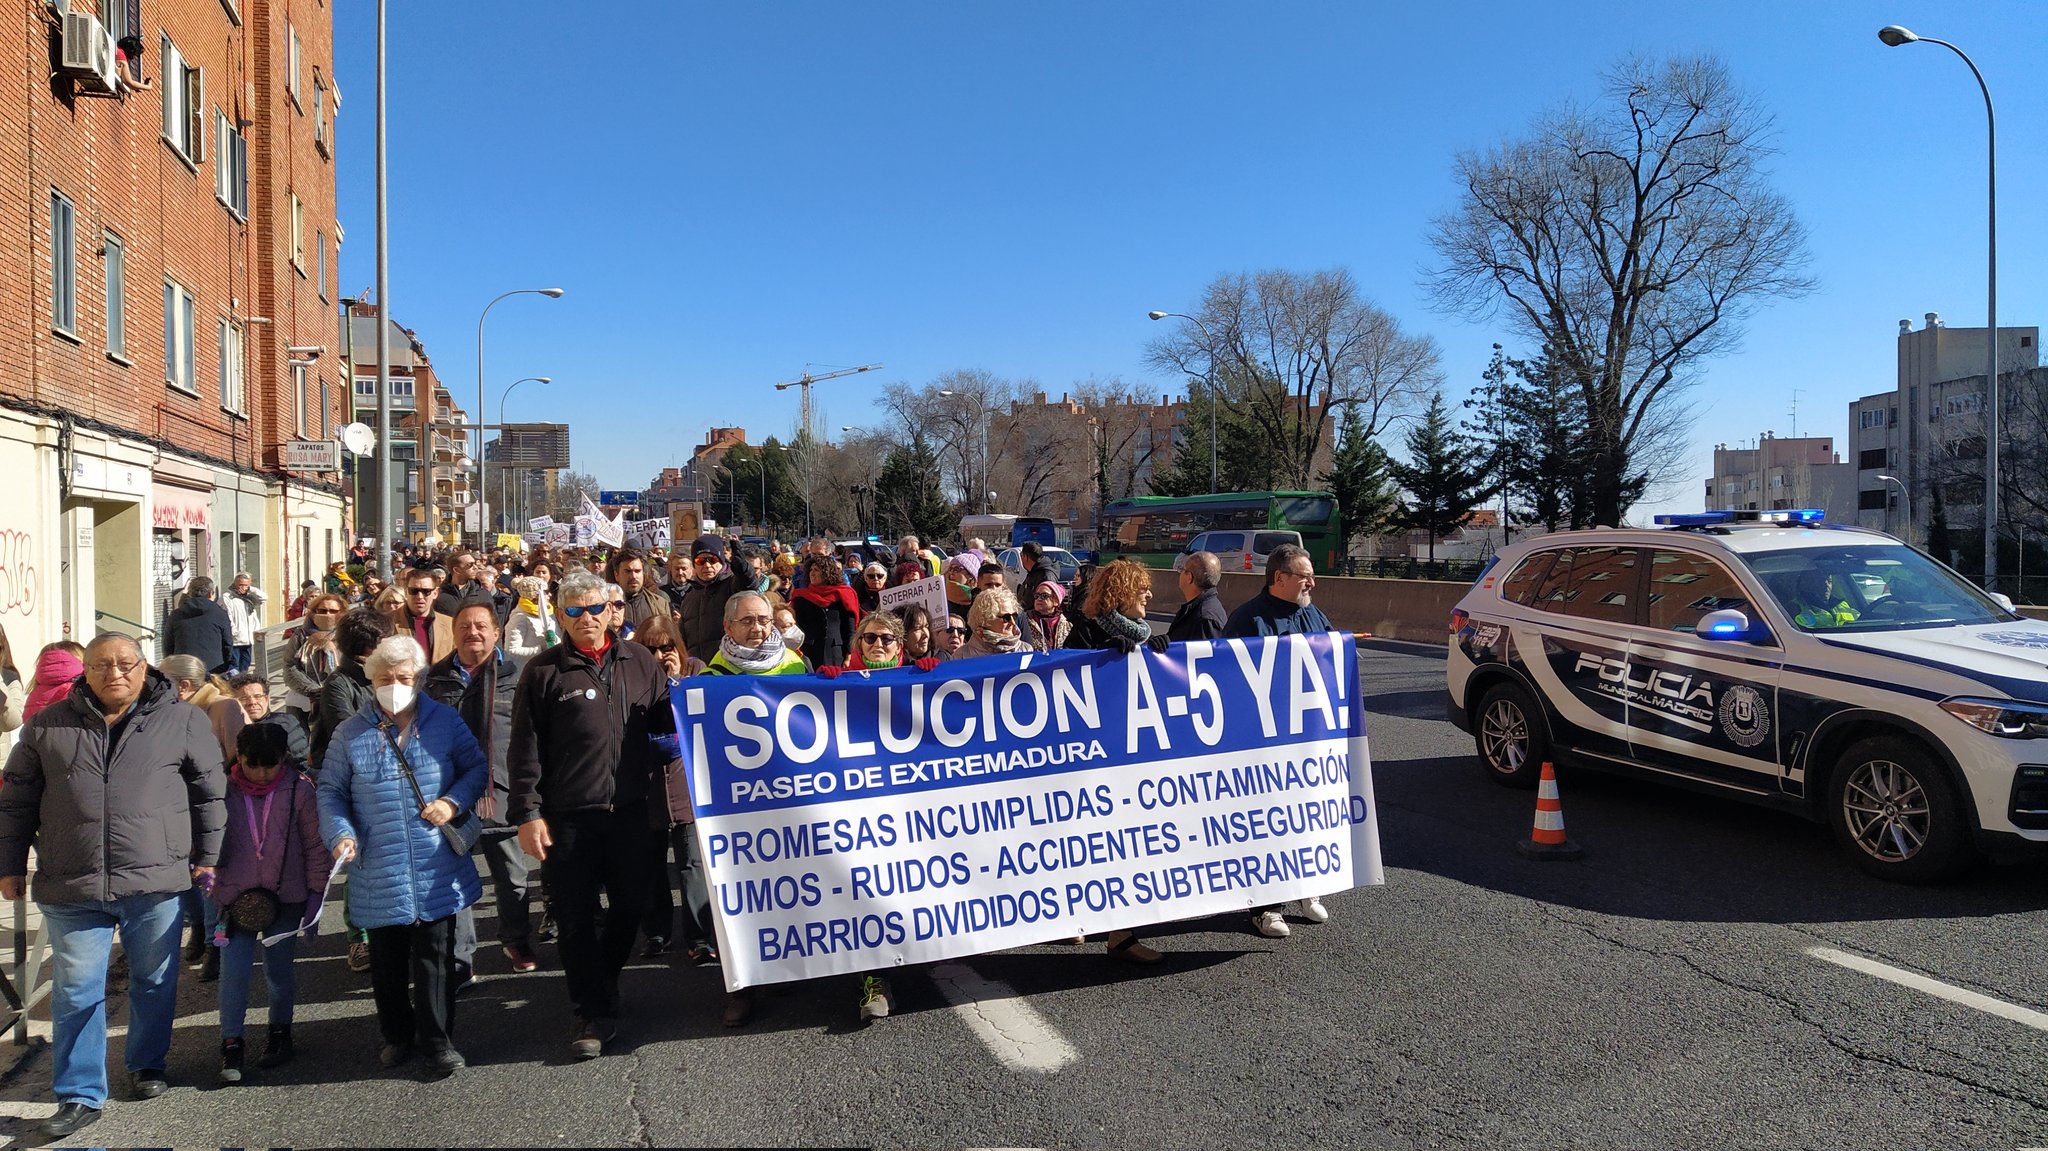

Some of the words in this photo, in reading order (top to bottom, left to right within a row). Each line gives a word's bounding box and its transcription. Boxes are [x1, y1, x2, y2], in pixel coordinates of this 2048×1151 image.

[288, 451, 308, 463] ROSA
[311, 452, 332, 464] MARY
[882, 585, 924, 606] SOTERRAR
[927, 580, 941, 594] A-5
[1126, 640, 1225, 754] A-5
[1226, 631, 1351, 738] YA!
[1651, 695, 1714, 721] MADRID
[708, 813, 897, 869] PROMESAS
[905, 784, 1114, 843] INCUMPLIDAS
[1137, 748, 1351, 811] CONTAMINACIÓN
[731, 770, 837, 804] PASEO
[843, 766, 885, 791] DE
[890, 739, 1108, 786] EXTREMADURA
[714, 872, 822, 917] UMOS
[851, 852, 971, 901] RUIDOS
[996, 821, 1181, 880] ACCIDENTES
[1202, 795, 1368, 848] INSEGURIDAD
[758, 911, 906, 962] BARRIOS
[912, 886, 1060, 942] DIVIDIDOS
[1065, 876, 1130, 917] POR
[1132, 842, 1341, 905] SUBTERRANEOS
